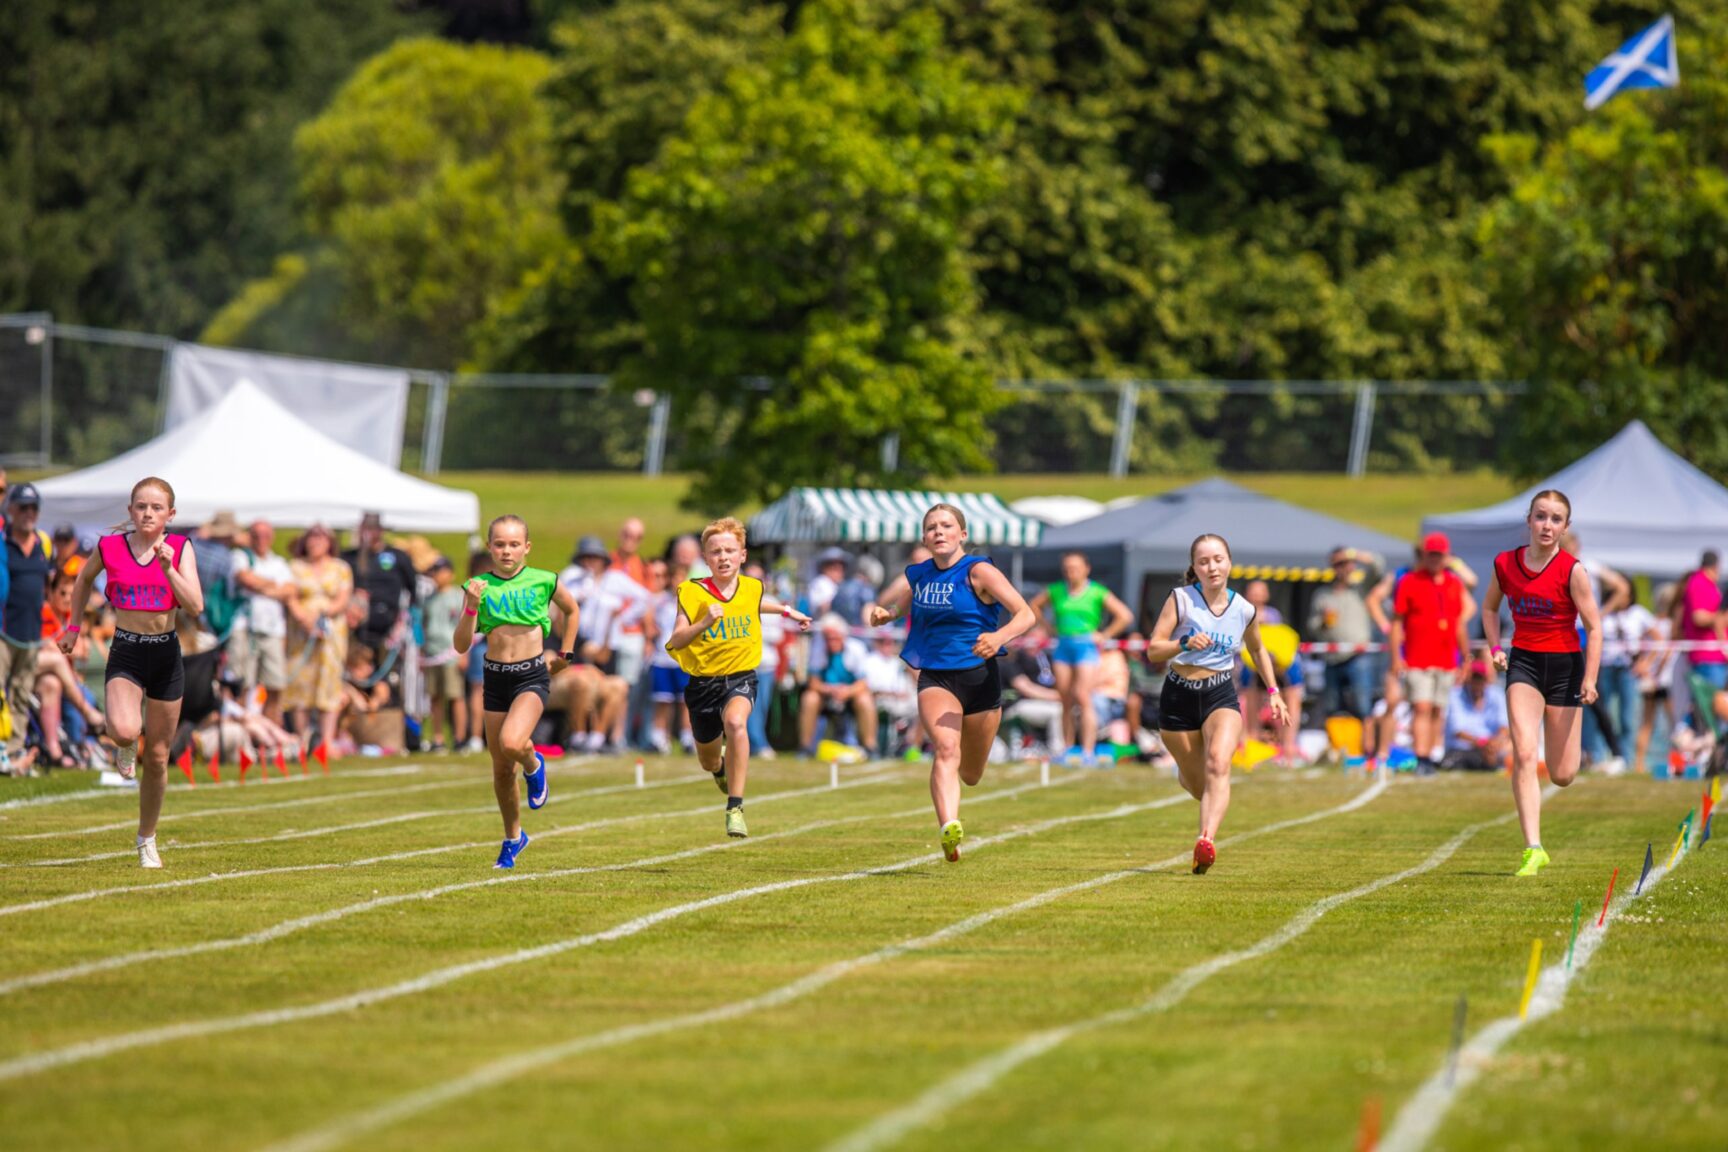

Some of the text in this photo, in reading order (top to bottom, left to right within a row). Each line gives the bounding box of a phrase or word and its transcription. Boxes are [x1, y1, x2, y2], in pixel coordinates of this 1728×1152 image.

[914, 582, 954, 604] MILLS
[486, 588, 536, 617] MILLS
[139, 634, 170, 644] PRO
[501, 661, 532, 673] PRO
[1176, 677, 1203, 690] PRO
